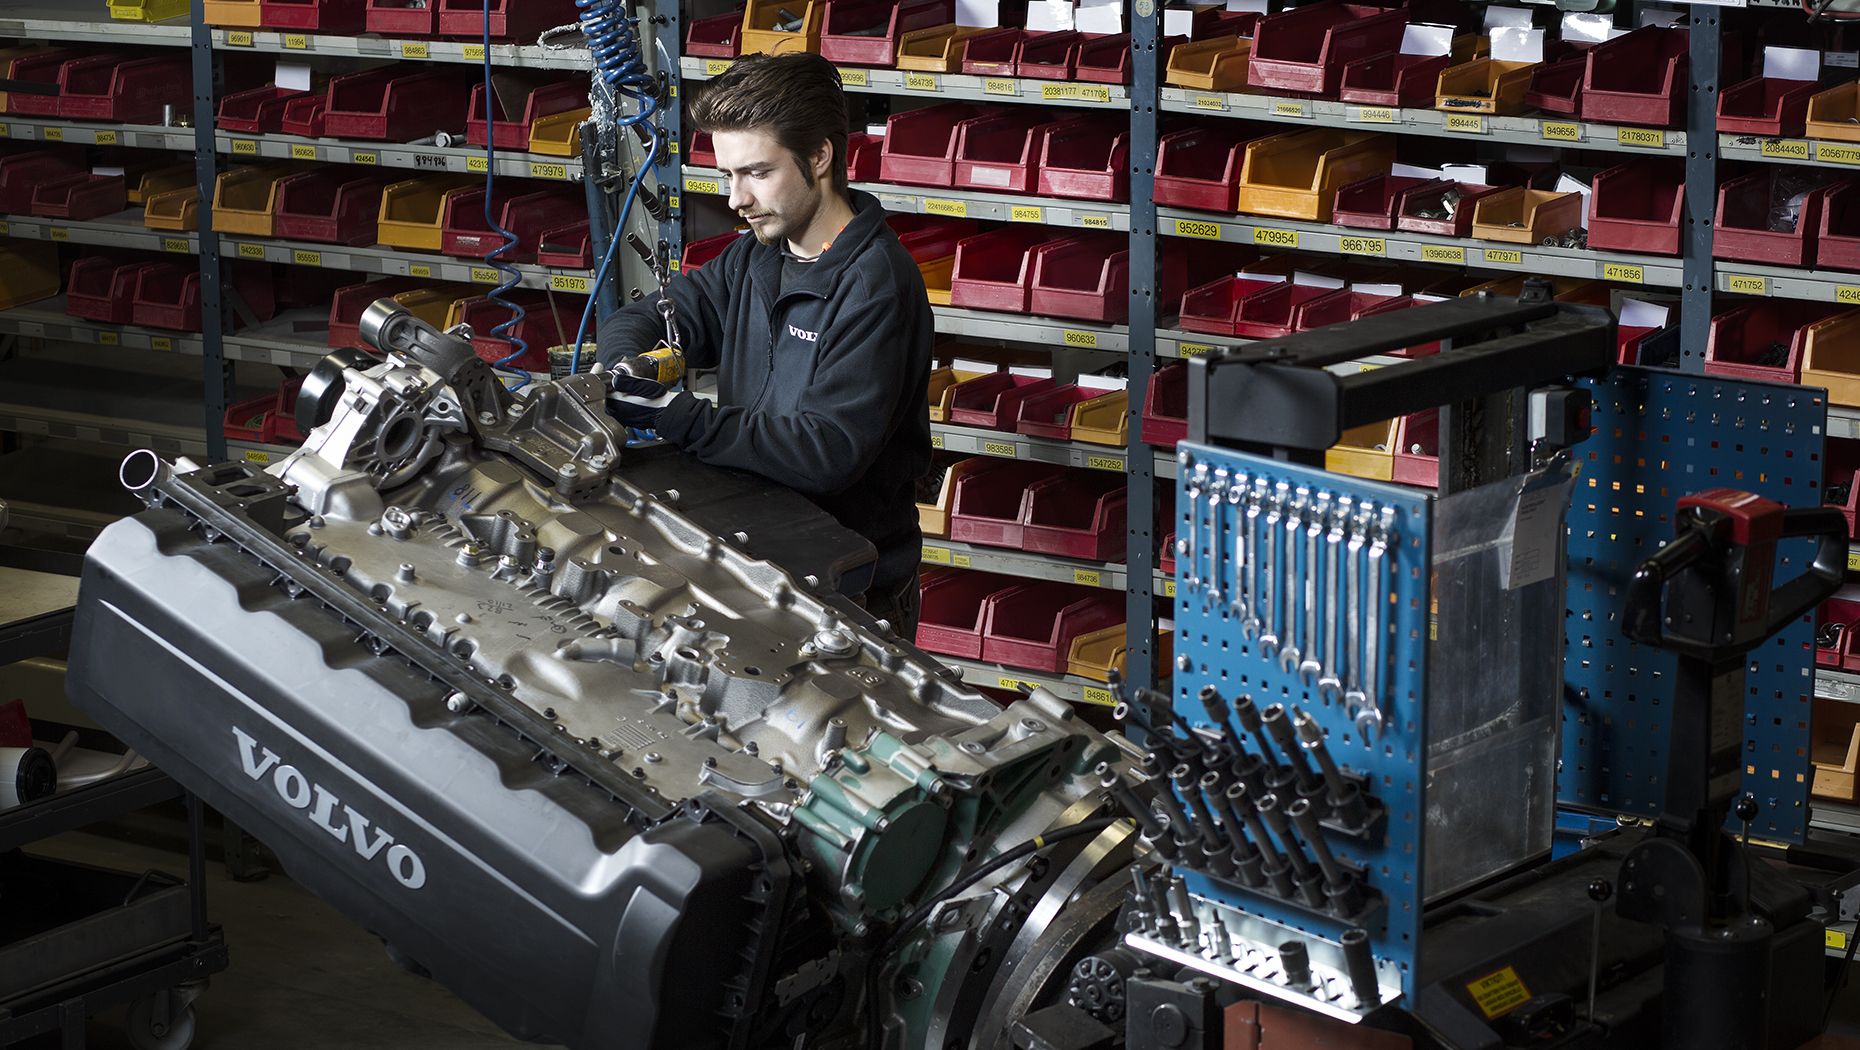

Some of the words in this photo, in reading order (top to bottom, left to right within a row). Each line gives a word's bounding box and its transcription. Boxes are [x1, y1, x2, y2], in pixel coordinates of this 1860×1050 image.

[909, 78, 933, 87] 984739
[1045, 87, 1076, 95] 20381177
[1082, 89, 1107, 98] 471708
[1363, 110, 1390, 119] 994446
[1450, 118, 1478, 127] 994445
[1547, 126, 1575, 136] 949656
[1622, 128, 1660, 142] 21780371
[1821, 148, 1860, 160] 20567779
[533, 165, 563, 176] 479979
[688, 181, 715, 192] 994556
[1180, 222, 1217, 236] 952629
[1256, 230, 1294, 244] 479954
[1342, 239, 1382, 252] 966795
[297, 253, 318, 262] 955537
[1426, 250, 1461, 259] 13960638
[1487, 251, 1517, 261] 477971
[474, 271, 497, 280] 955542
[1607, 268, 1640, 279] 471856
[554, 277, 585, 289] 951973
[1733, 280, 1762, 290] 471752
[1067, 333, 1095, 344] 960632
[986, 444, 1013, 455] 983585
[1090, 459, 1121, 469] 1547252
[232, 726, 426, 889] VOLVO
